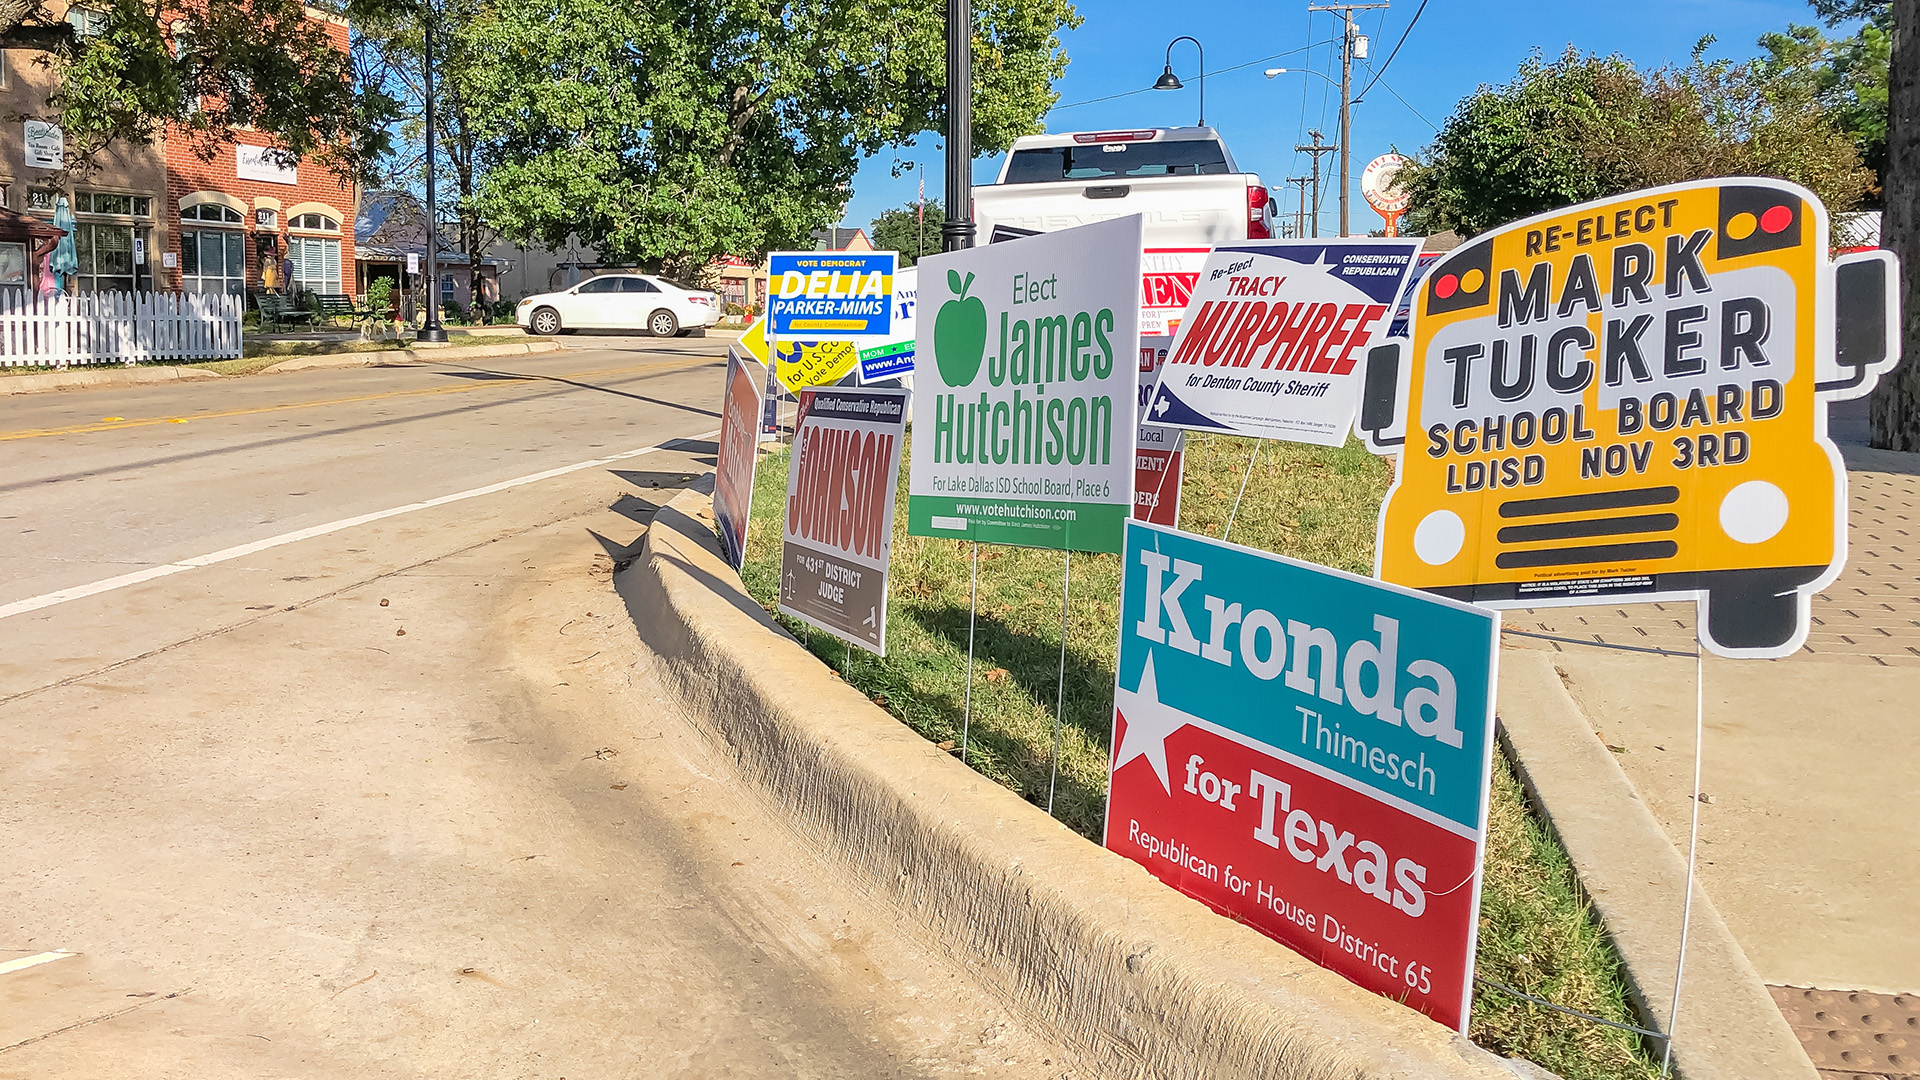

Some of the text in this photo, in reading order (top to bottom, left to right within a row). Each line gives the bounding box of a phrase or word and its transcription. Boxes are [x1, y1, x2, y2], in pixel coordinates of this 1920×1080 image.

[1526, 199, 1678, 258] RE-ELECT
[1210, 256, 1254, 282] Re-Elect
[1342, 267, 1400, 276] REPUBLICAN
[1343, 254, 1410, 264] CONSERVATIVE
[778, 270, 884, 300] DELIA
[1013, 272, 1058, 304] Elect
[1226, 276, 1287, 296] TRACY
[1498, 228, 1714, 330] MARK
[774, 301, 884, 316] PARKER-MIMS
[863, 349, 885, 358] MOM
[988, 308, 1114, 387] James
[1171, 301, 1388, 376] MURPHREE
[1444, 296, 1772, 409] TUCKER
[786, 374, 805, 386] for
[806, 368, 828, 386] Vote
[1185, 373, 1330, 398] for Denton County Sheriff
[814, 397, 902, 416] Qualified Conservative Republican
[1426, 378, 1784, 459] SCHOOL BOARD
[934, 384, 1112, 466] Hutchison
[1140, 428, 1164, 443] Local
[1446, 430, 1750, 494] LDISD NOV 3RD
[788, 425, 894, 560] JOHNSON
[933, 476, 1110, 498] For Lake Dallas ISD School Board, Place 6
[956, 502, 1076, 521] www.votehutchison.com
[796, 554, 805, 564] FOR
[825, 562, 862, 589] DISTRICT
[818, 581, 845, 604] JUDGE
[1136, 548, 1464, 750] Kronda
[1294, 704, 1436, 796] Thimesch
[1182, 754, 1428, 919] for Texas
[1128, 818, 1218, 882] Republican
[1224, 864, 1252, 898] for
[1256, 886, 1317, 935] House
[1322, 914, 1400, 980] District
[1405, 959, 1432, 996] 65
